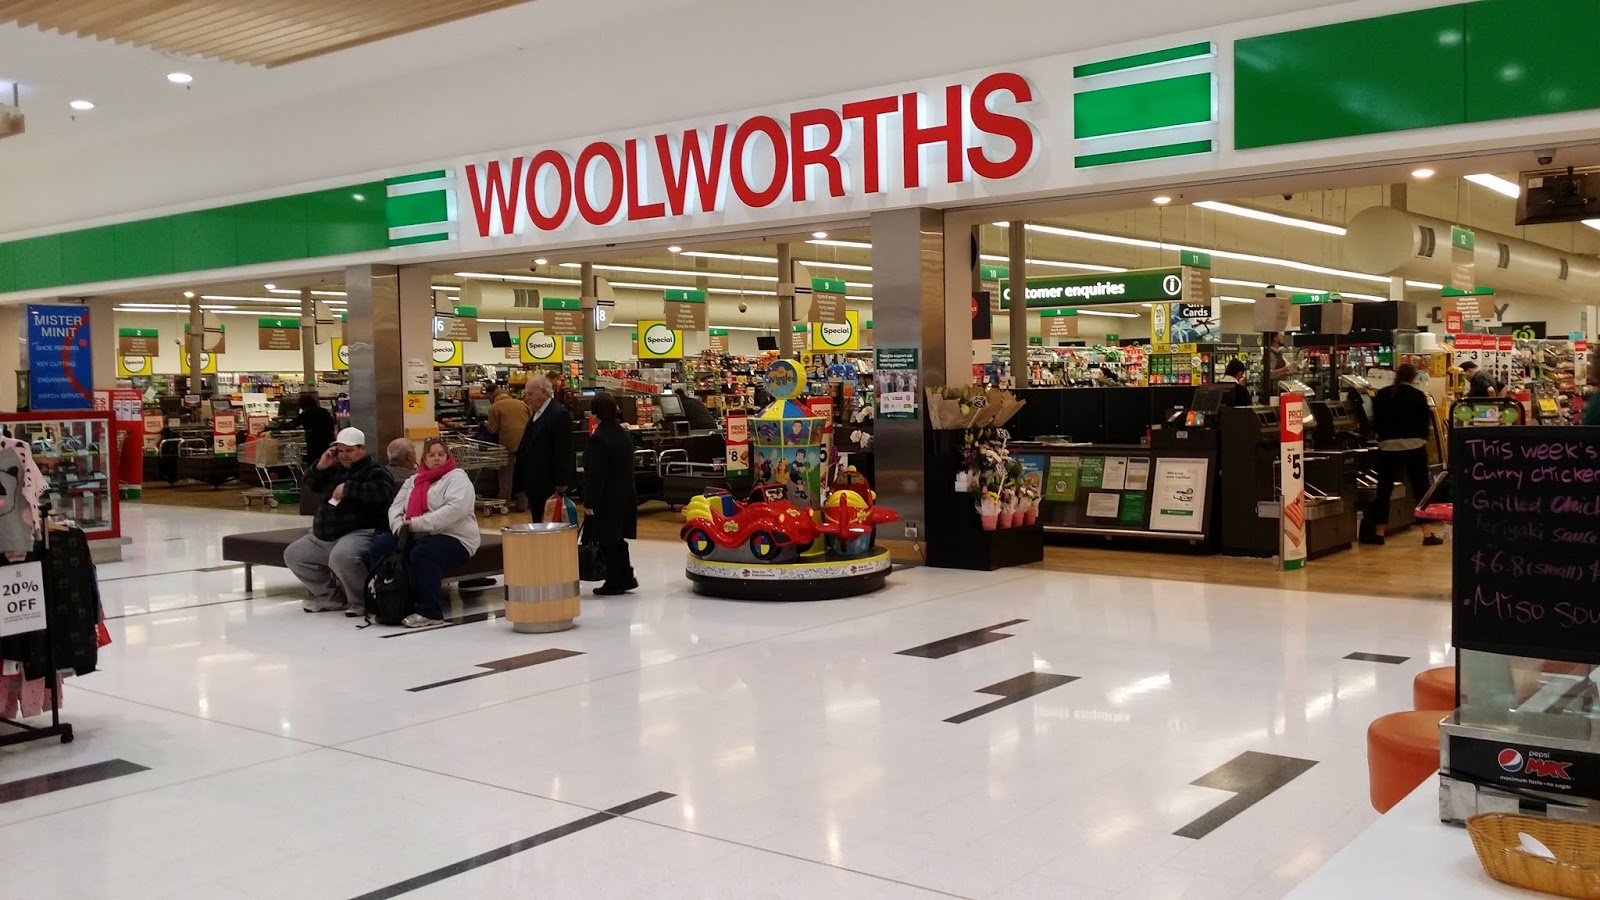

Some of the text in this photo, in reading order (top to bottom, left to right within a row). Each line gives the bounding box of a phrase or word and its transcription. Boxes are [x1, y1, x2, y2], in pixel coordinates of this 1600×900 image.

[465, 72, 1034, 237] WOOLWORTHS
[1193, 255, 1199, 264] 11
[990, 269, 997, 278] 10
[824, 281, 830, 290] 9
[1003, 281, 1125, 300] Ctomer enquiries
[683, 292, 688, 300] 8
[1311, 294, 1320, 302] 10
[560, 300, 566, 308] 7
[599, 309, 606, 322] 8
[1183, 307, 1208, 317] Cards
[34, 315, 83, 326] MISTER
[437, 320, 444, 331] 6
[41, 327, 77, 338] MINIT
[823, 327, 850, 335] Special
[529, 341, 553, 349] Special
[647, 335, 676, 345] Special
[432, 346, 453, 354] pecial
[814, 409, 831, 417] PRICE
[1288, 409, 1302, 419] PRICE
[1465, 439, 1598, 461] This week's
[1287, 453, 1301, 480] $5
[1472, 462, 1523, 490] Curry
[1472, 490, 1542, 513] Grilled
[3, 581, 39, 597] 20%
[7, 598, 37, 613] OFF
[1474, 584, 1545, 625] Miso
[1528, 751, 1550, 760] pepsi
[1525, 758, 1574, 780] MAX
[1500, 775, 1528, 783] maximum
[1529, 778, 1543, 786] taste
[1555, 782, 1572, 790] sugar
